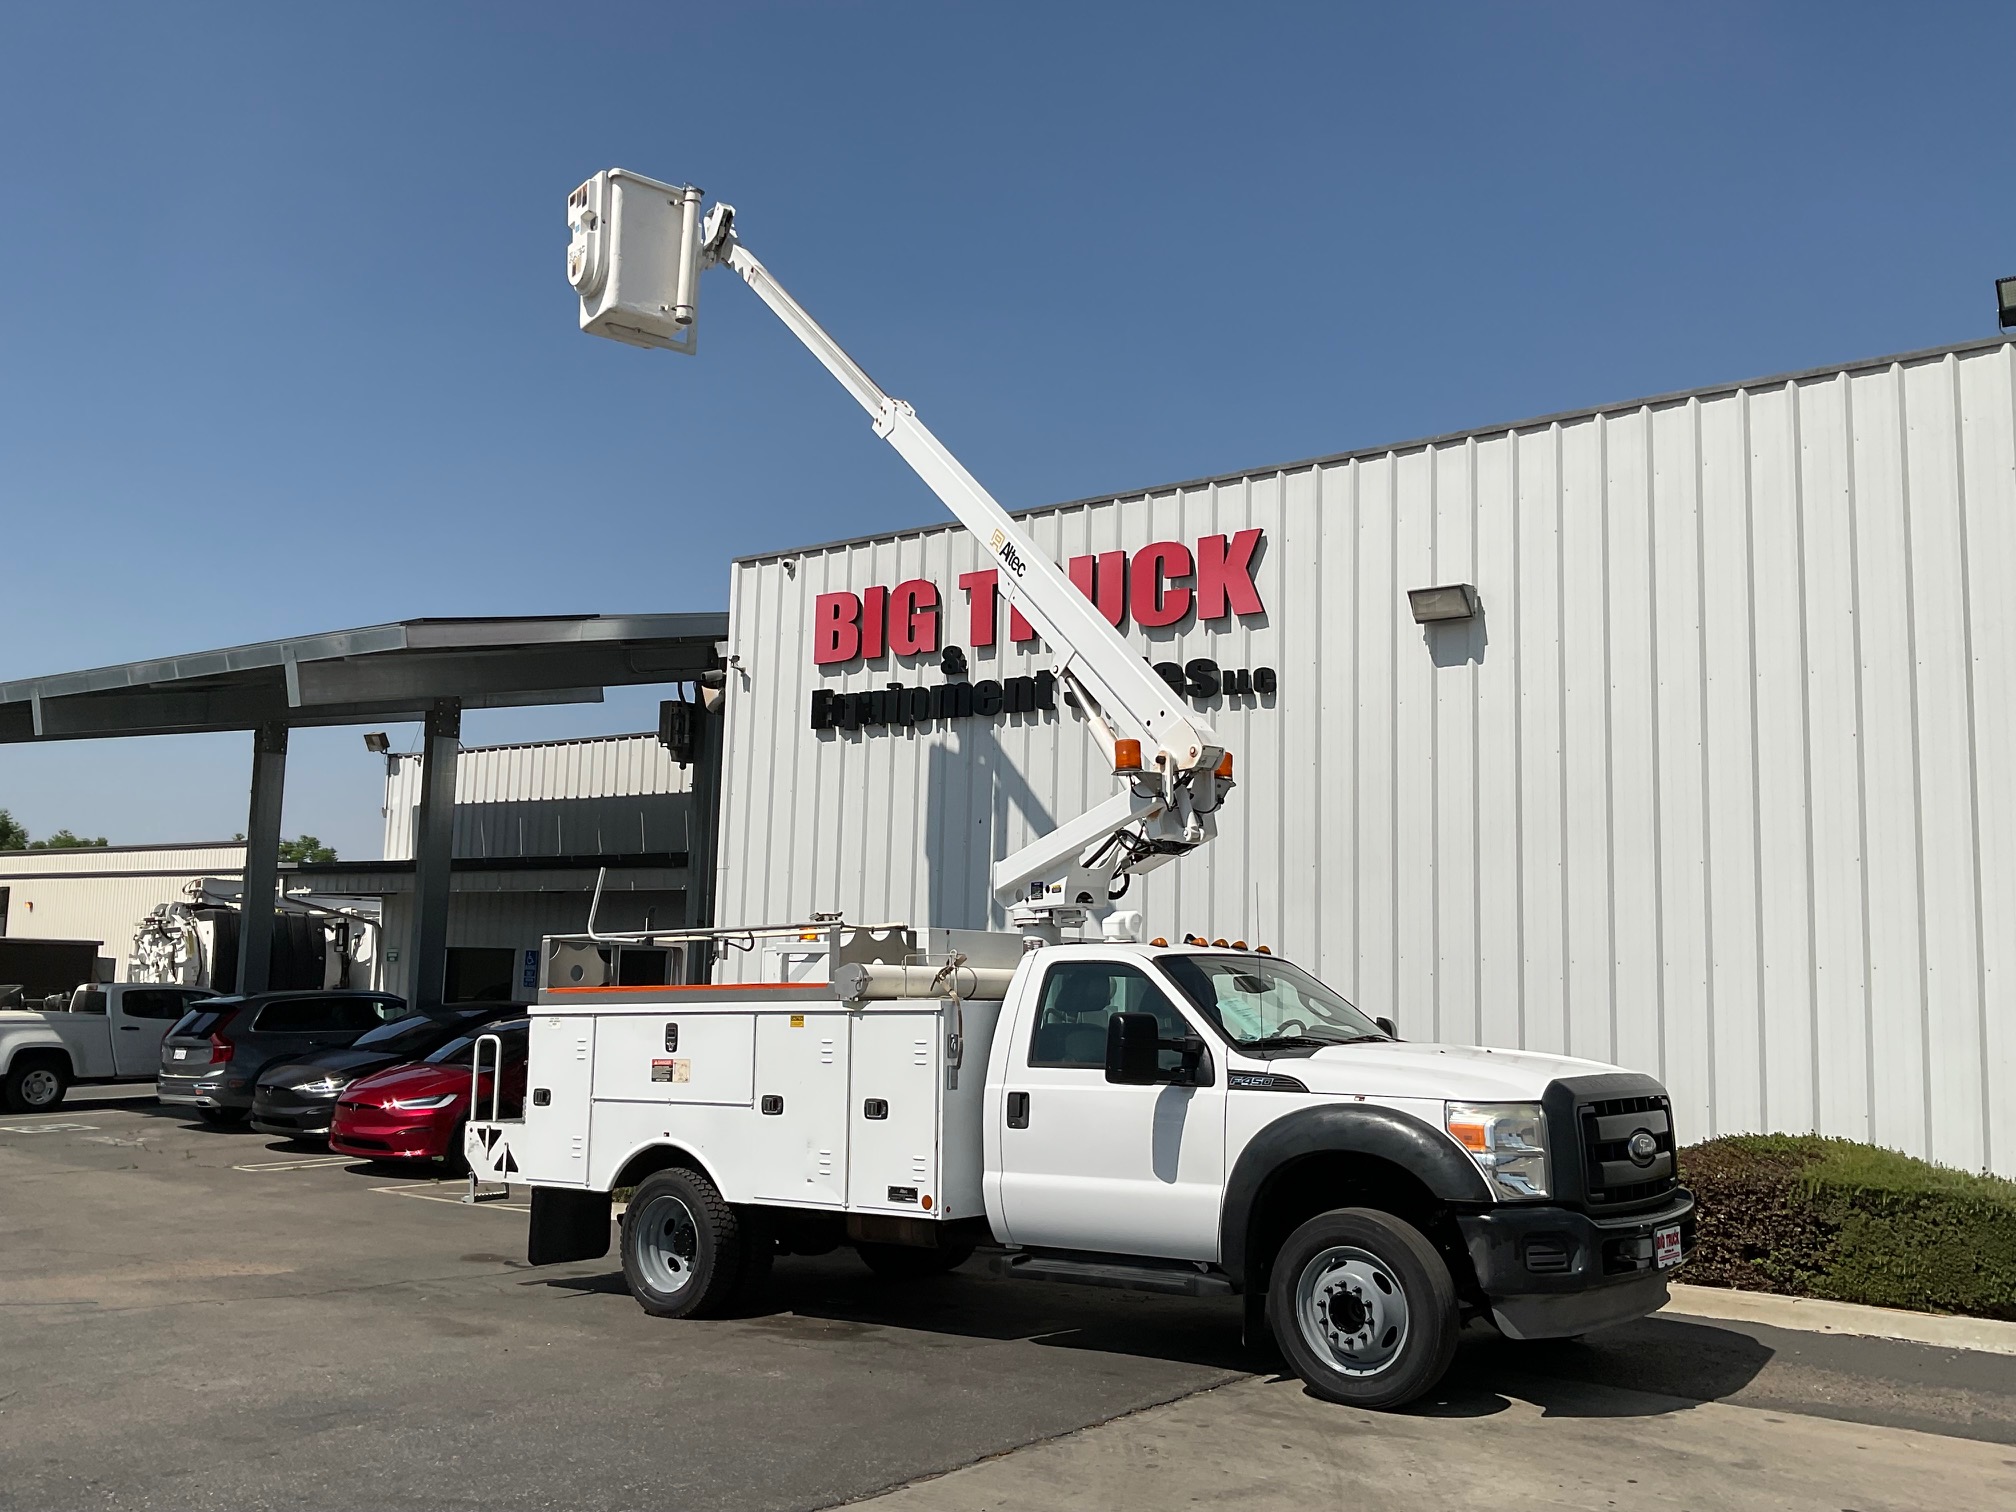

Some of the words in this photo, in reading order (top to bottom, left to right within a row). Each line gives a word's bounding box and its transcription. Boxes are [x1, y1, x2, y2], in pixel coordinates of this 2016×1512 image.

[999, 541, 1026, 577] Altec
[814, 578, 940, 665] BIG
[959, 528, 1264, 648] TUCK
[941, 645, 968, 675] &
[811, 669, 1056, 730] Equipment
